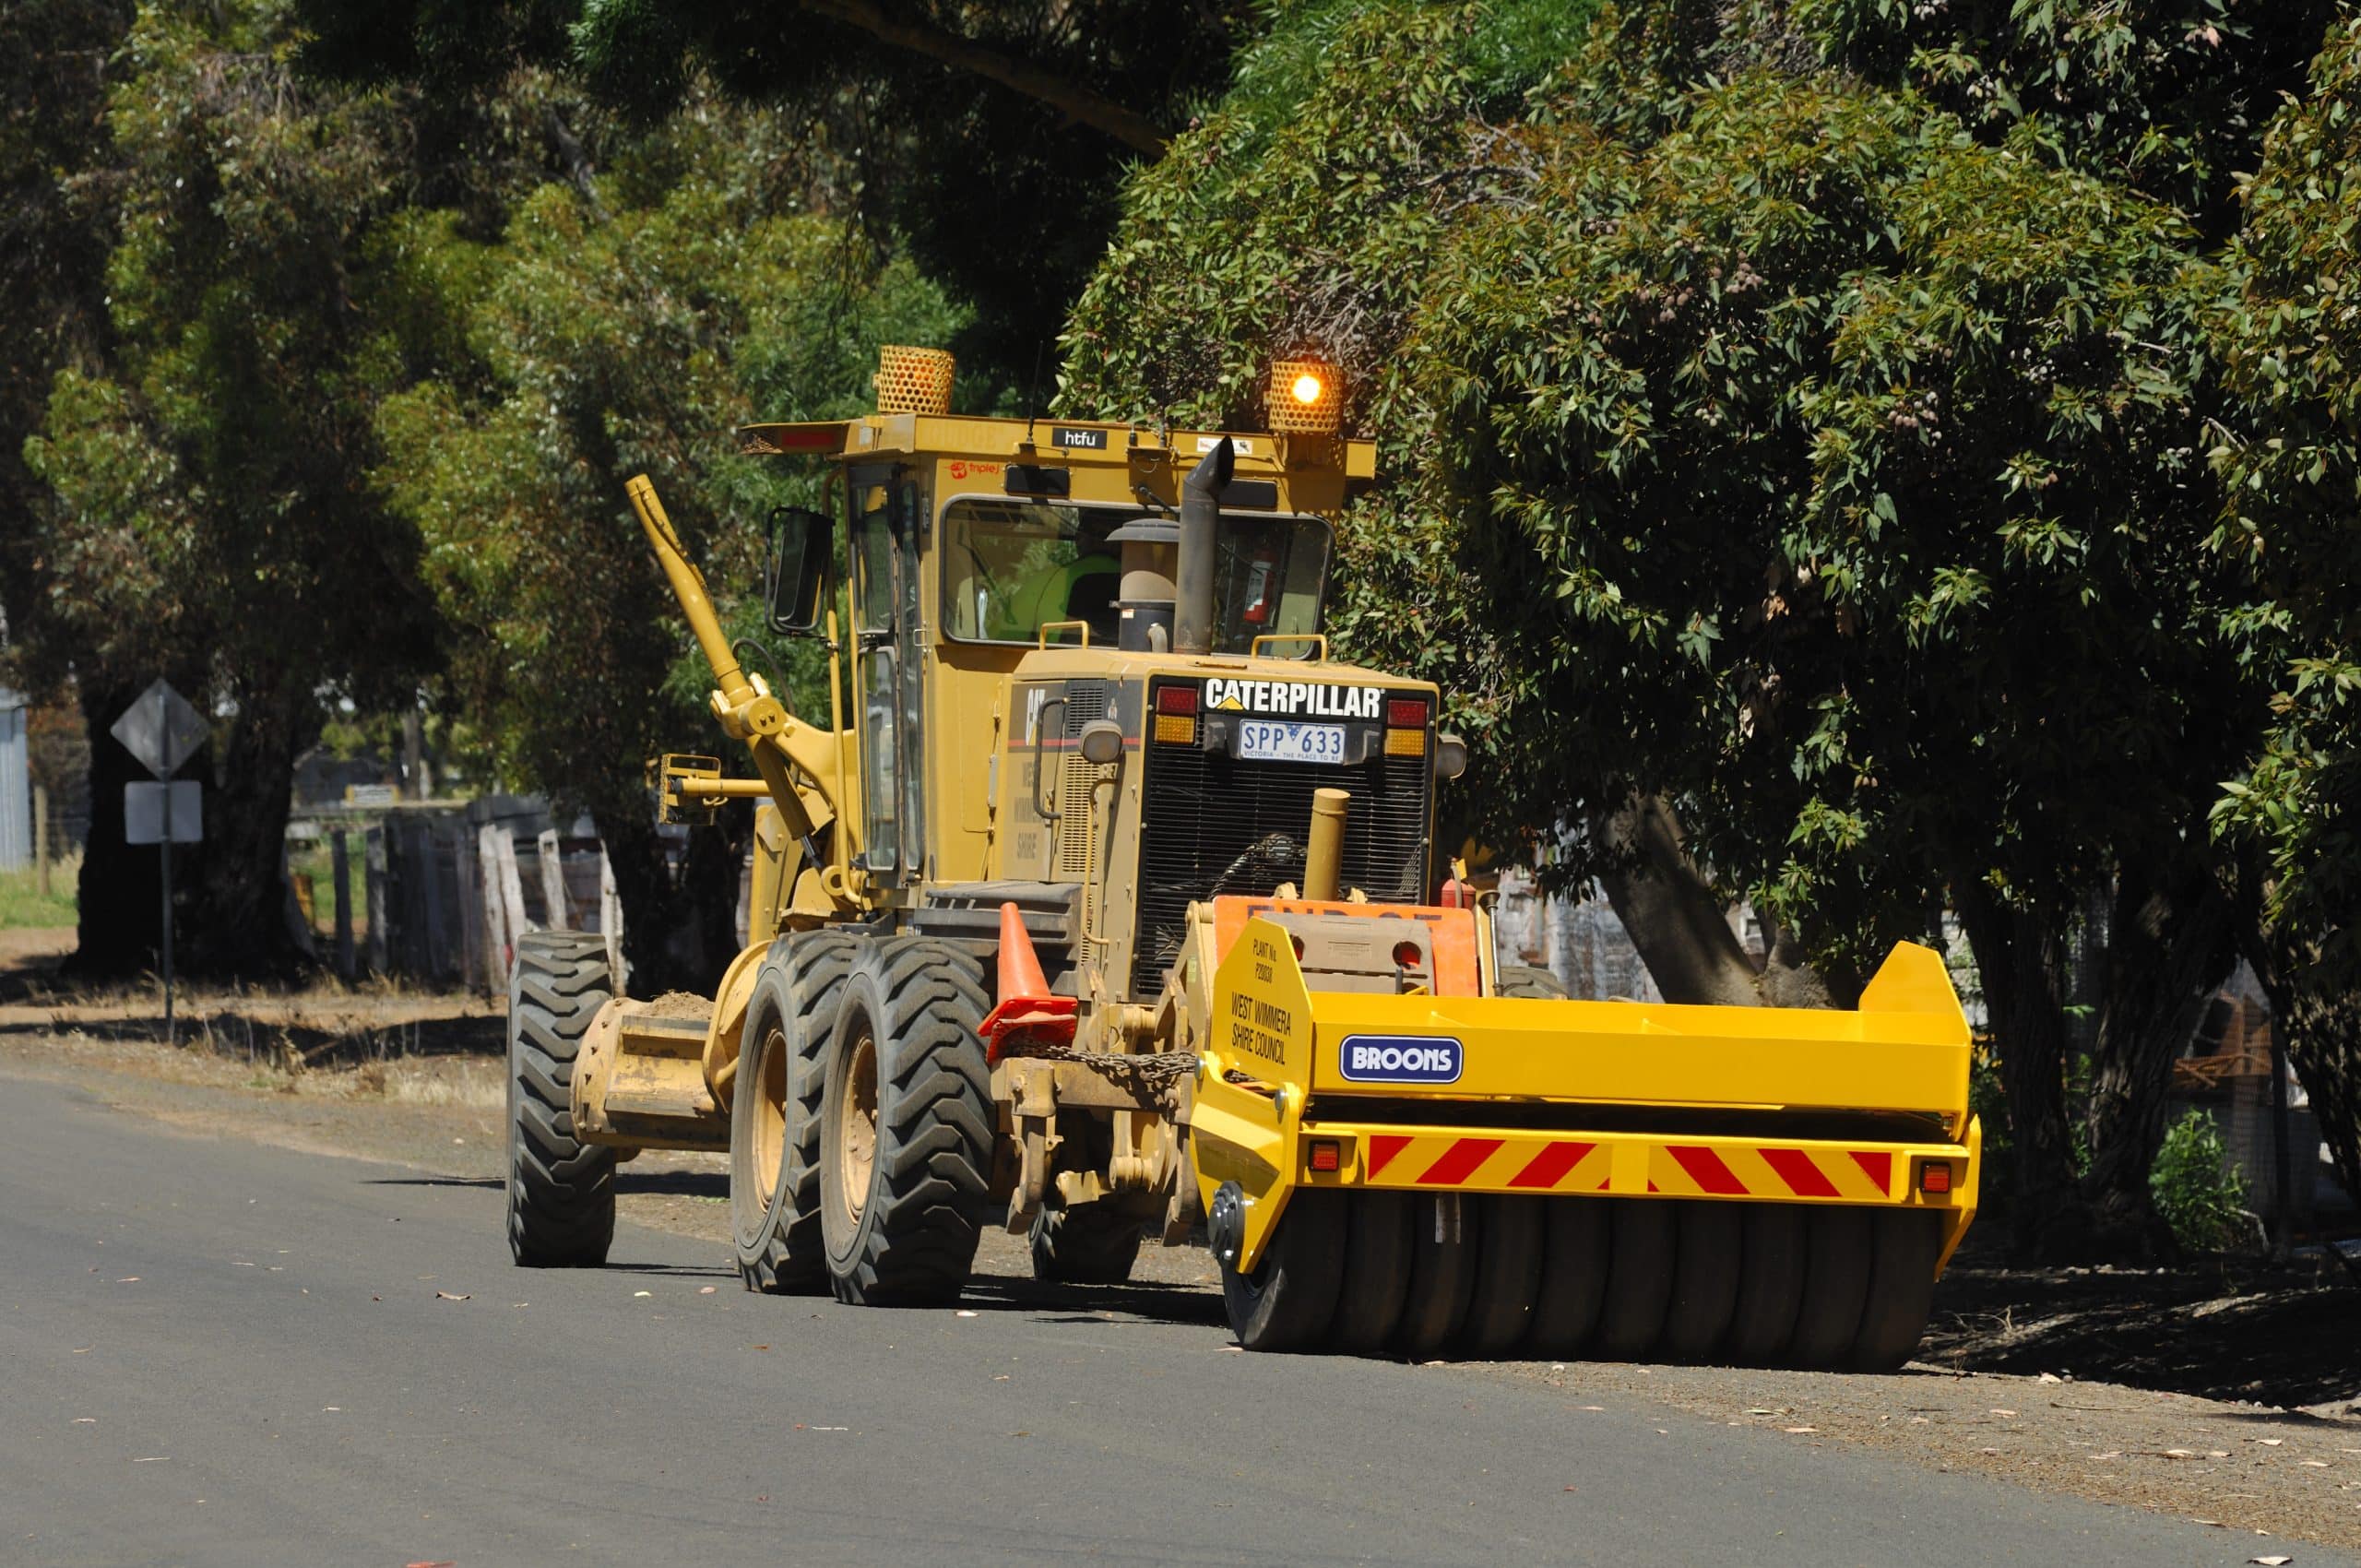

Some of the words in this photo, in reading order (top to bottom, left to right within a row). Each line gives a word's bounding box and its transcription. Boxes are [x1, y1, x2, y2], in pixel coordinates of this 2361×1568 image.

[1064, 430, 1097, 446] htfu
[1205, 678, 1381, 719] CATERPILLAR
[1244, 727, 1284, 751] SPP
[1301, 730, 1341, 754] 633
[1252, 938, 1269, 959] PLANT
[1231, 991, 1253, 1022] WEST
[1254, 999, 1291, 1038] WIMMERA
[1232, 1022, 1254, 1053] SHIRE
[1254, 1030, 1286, 1066] COUNCIL
[1352, 1046, 1453, 1072] BROONS
